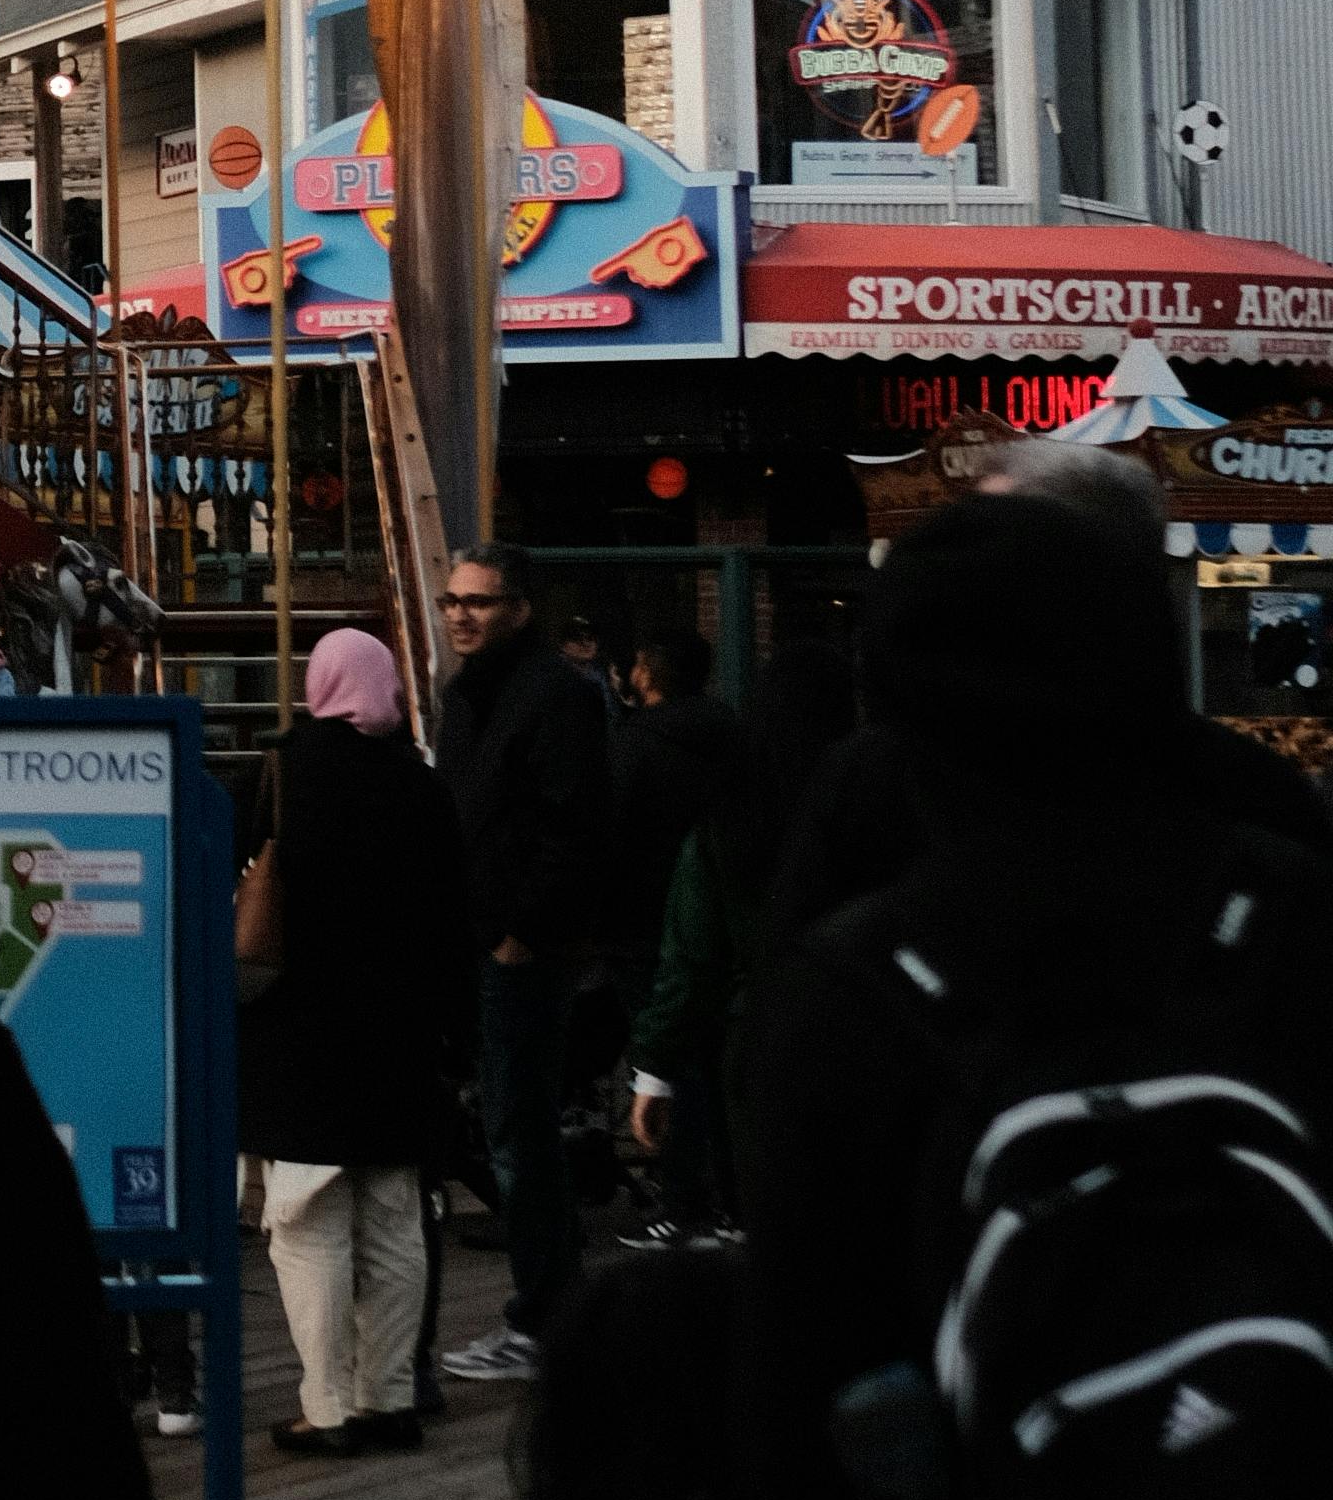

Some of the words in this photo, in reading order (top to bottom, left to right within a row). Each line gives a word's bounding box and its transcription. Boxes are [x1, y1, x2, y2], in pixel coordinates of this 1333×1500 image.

[798, 49, 879, 79] BUBBA
[878, 45, 949, 81] GUMP
[332, 152, 579, 204] PLRS
[319, 307, 388, 327] MEET
[501, 301, 598, 323] MPETE
[848, 276, 1202, 324] SPORTSGRILL
[790, 331, 876, 349] FAMILY
[891, 331, 976, 351] DINING
[984, 333, 998, 350] &
[1009, 333, 1084, 351] GAMES
[980, 375, 1117, 430] LOUNG
